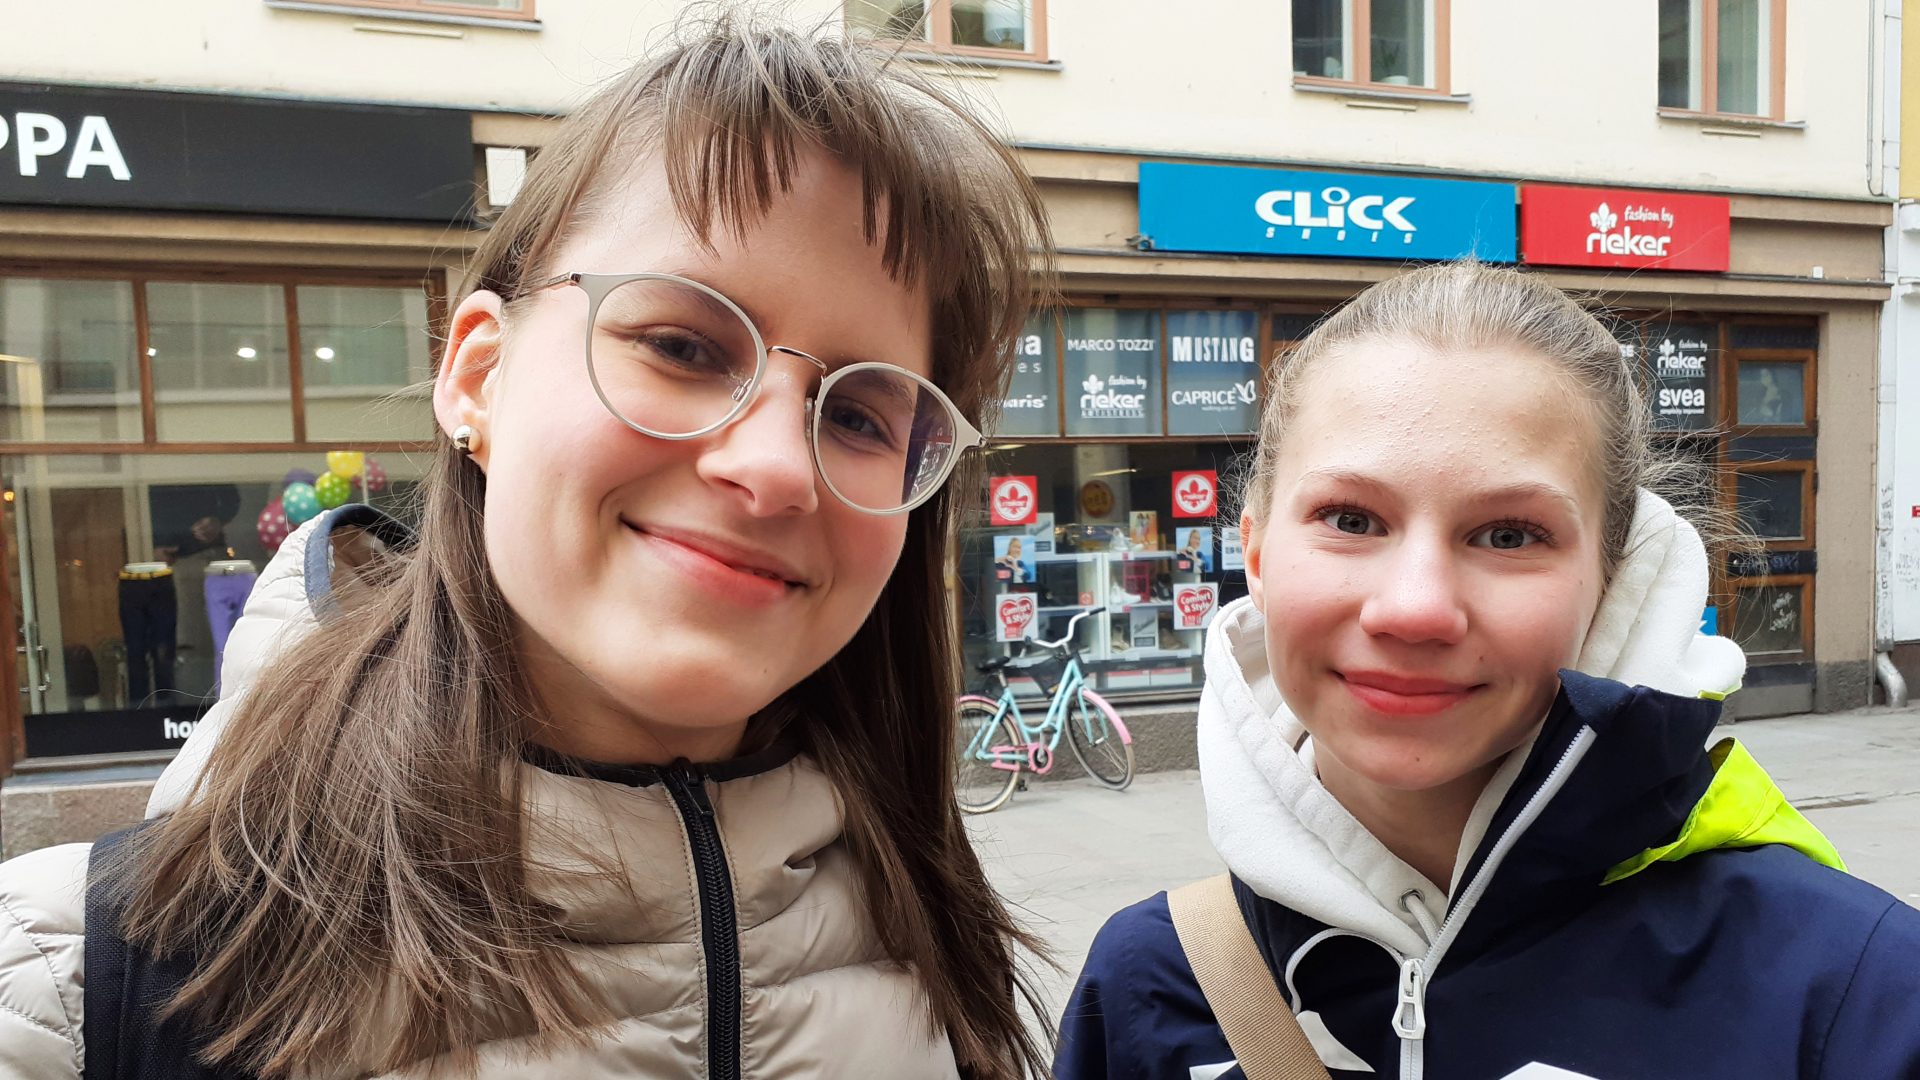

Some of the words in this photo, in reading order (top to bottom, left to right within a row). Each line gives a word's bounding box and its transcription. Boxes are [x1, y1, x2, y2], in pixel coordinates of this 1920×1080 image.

[0, 112, 132, 180] PA
[1624, 204, 1660, 222] fashion
[1661, 206, 1674, 229] by
[1586, 225, 1671, 256] rieker
[1067, 339, 1115, 351] MARCO
[1116, 339, 1154, 351] TOZZI
[1172, 336, 1255, 363] MUSTANG
[1657, 351, 1706, 369] rieker
[1080, 389, 1145, 408] rieker
[1171, 390, 1237, 405] CAPRICE
[1659, 388, 1705, 407] svea
[1181, 592, 1211, 605] Comfort
[164, 718, 198, 739] ho
